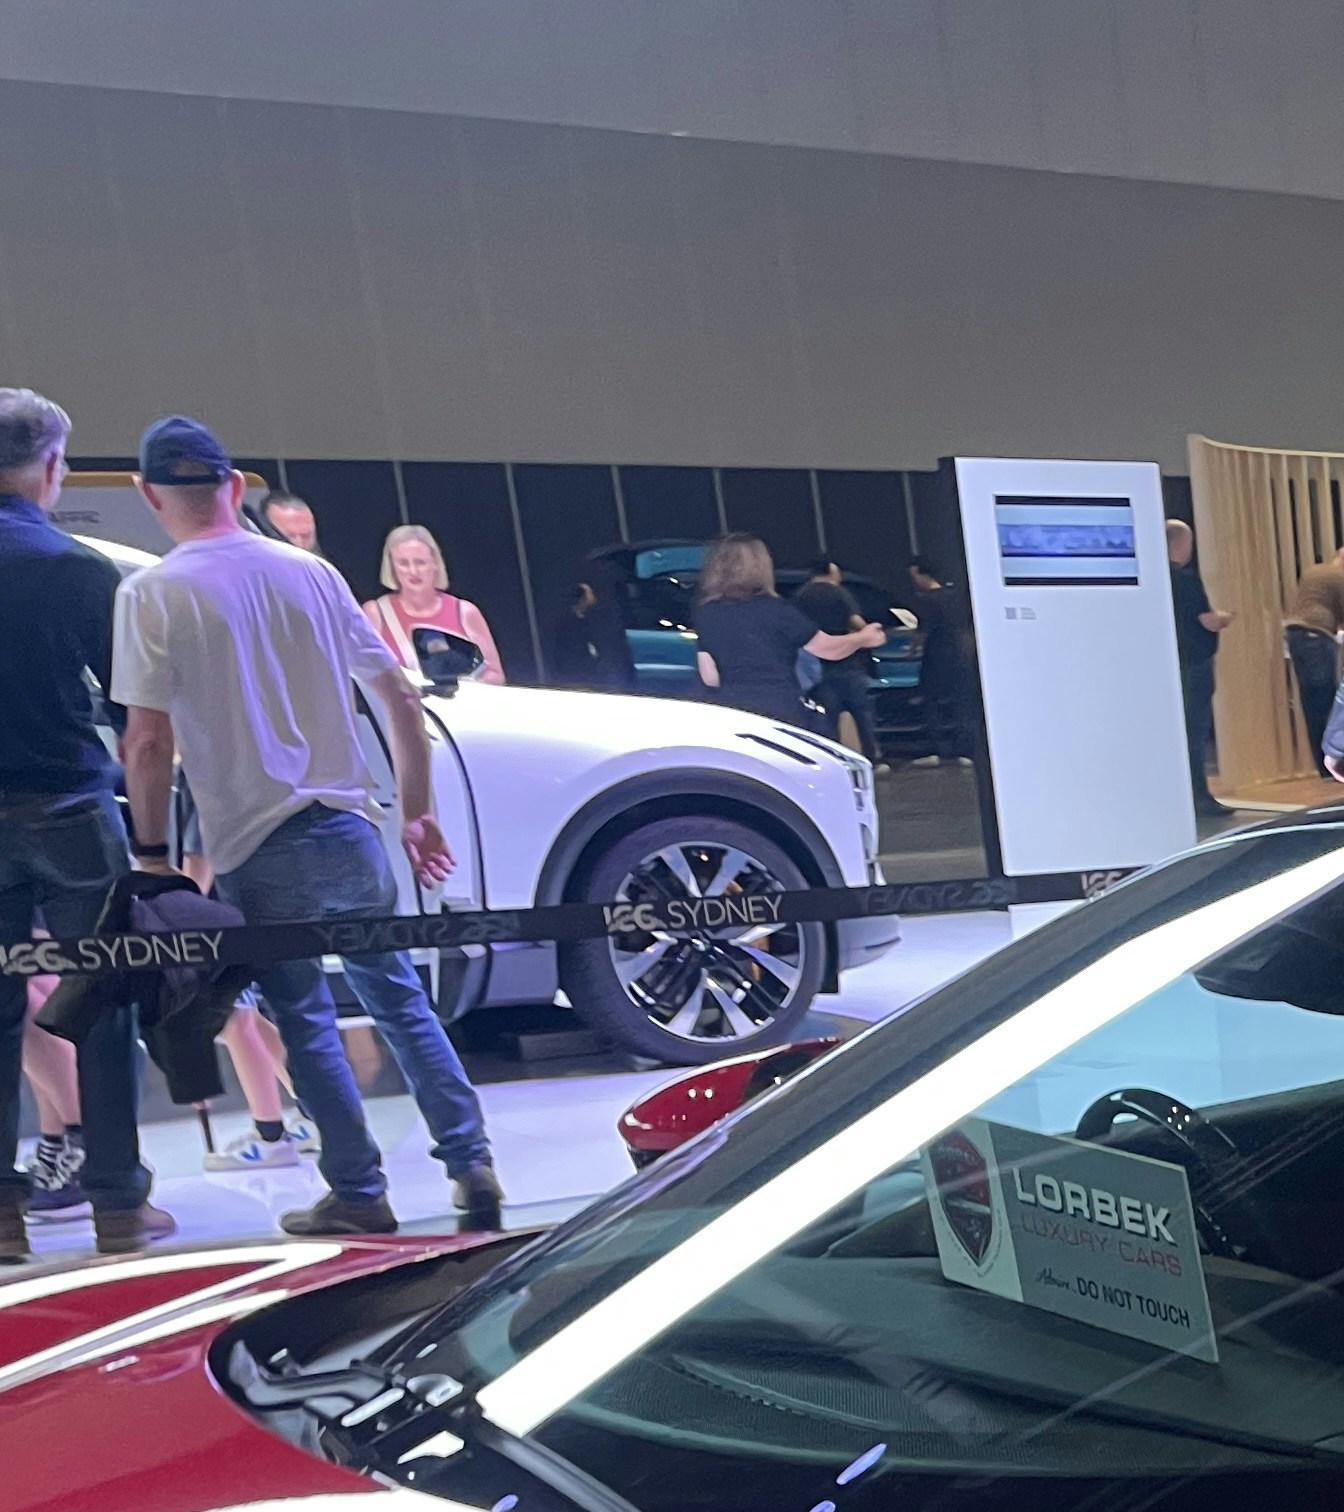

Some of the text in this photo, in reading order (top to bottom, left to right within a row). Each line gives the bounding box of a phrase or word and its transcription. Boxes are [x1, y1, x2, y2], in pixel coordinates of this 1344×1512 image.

[667, 894, 783, 930] SYDNEY
[78, 930, 224, 969] SYDNEY
[1012, 1166, 1178, 1247] LORBEK
[1021, 1212, 1183, 1277] LUXURY CARS
[1076, 1276, 1100, 1300] DO
[1102, 1283, 1133, 1310] NOT
[1135, 1294, 1191, 1329] TOUCH
